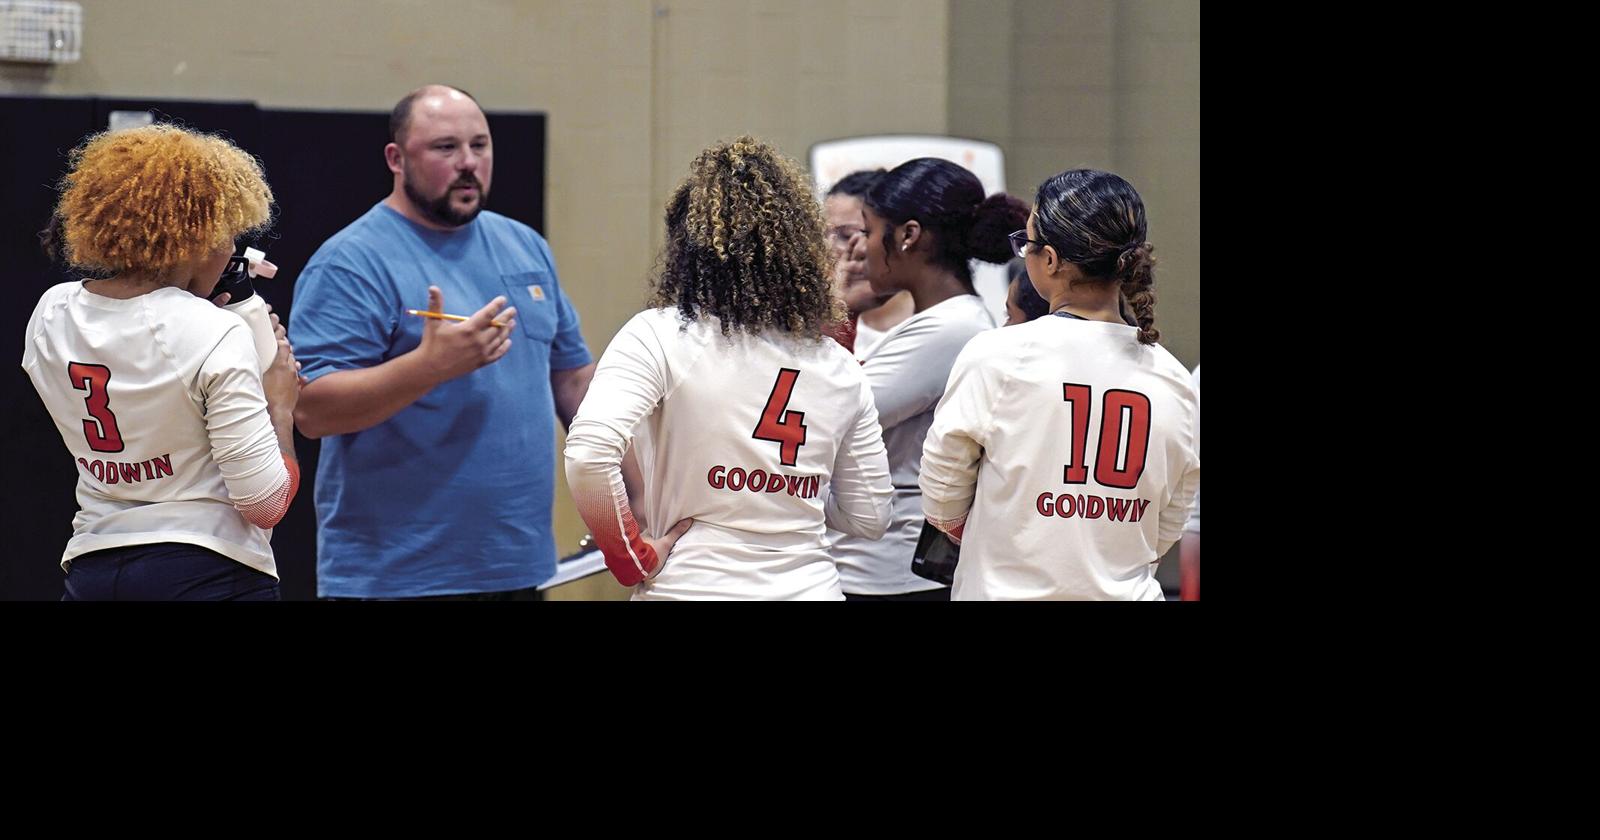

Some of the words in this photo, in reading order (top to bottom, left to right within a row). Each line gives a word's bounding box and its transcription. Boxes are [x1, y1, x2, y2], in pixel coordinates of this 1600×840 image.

[68, 361, 125, 453] 3
[752, 367, 807, 467] 4
[1063, 382, 1151, 489] 10
[78, 453, 173, 485] ODWIN
[708, 465, 820, 499] GOODWIN
